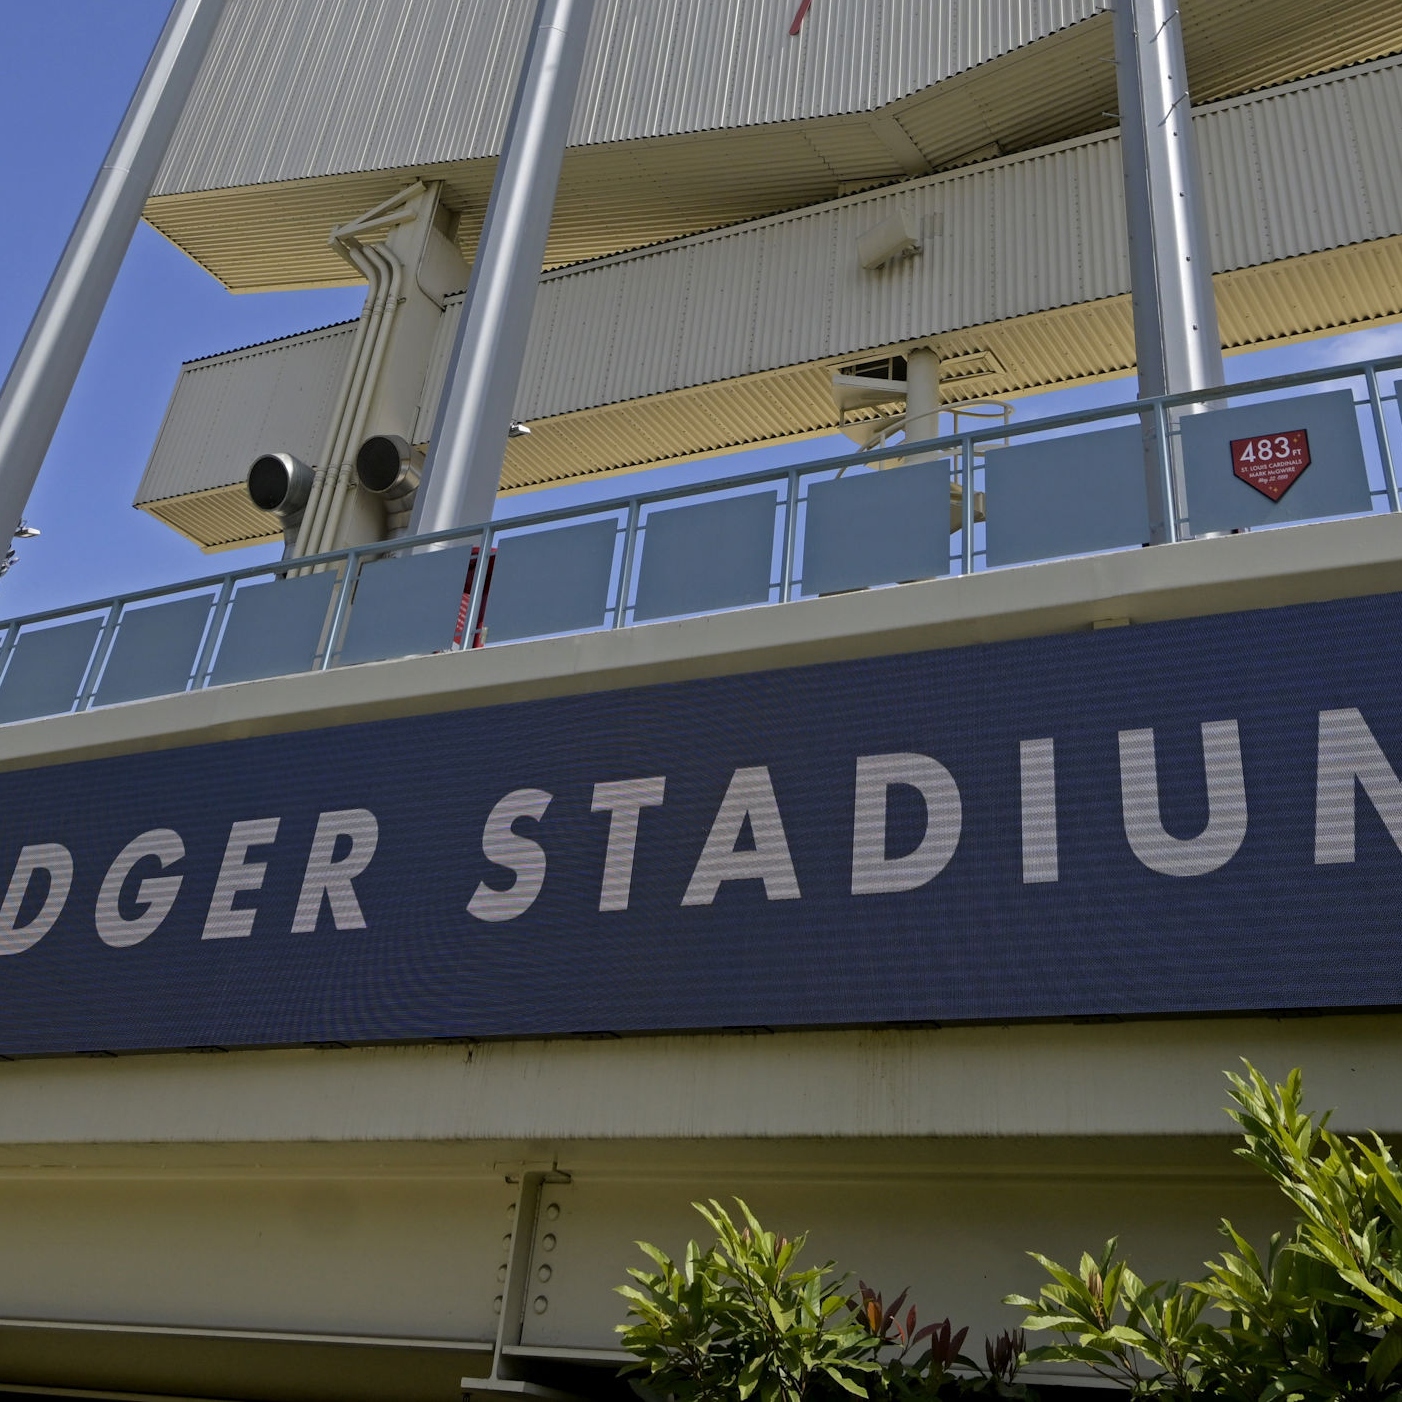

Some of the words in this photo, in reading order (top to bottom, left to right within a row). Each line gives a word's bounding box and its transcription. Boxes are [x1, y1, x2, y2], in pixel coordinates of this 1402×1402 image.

[1240, 436, 1291, 462] 483
[1250, 463, 1268, 471] LOUIS
[1269, 459, 1303, 469] CARDINALS
[1249, 470, 1267, 478] MARK
